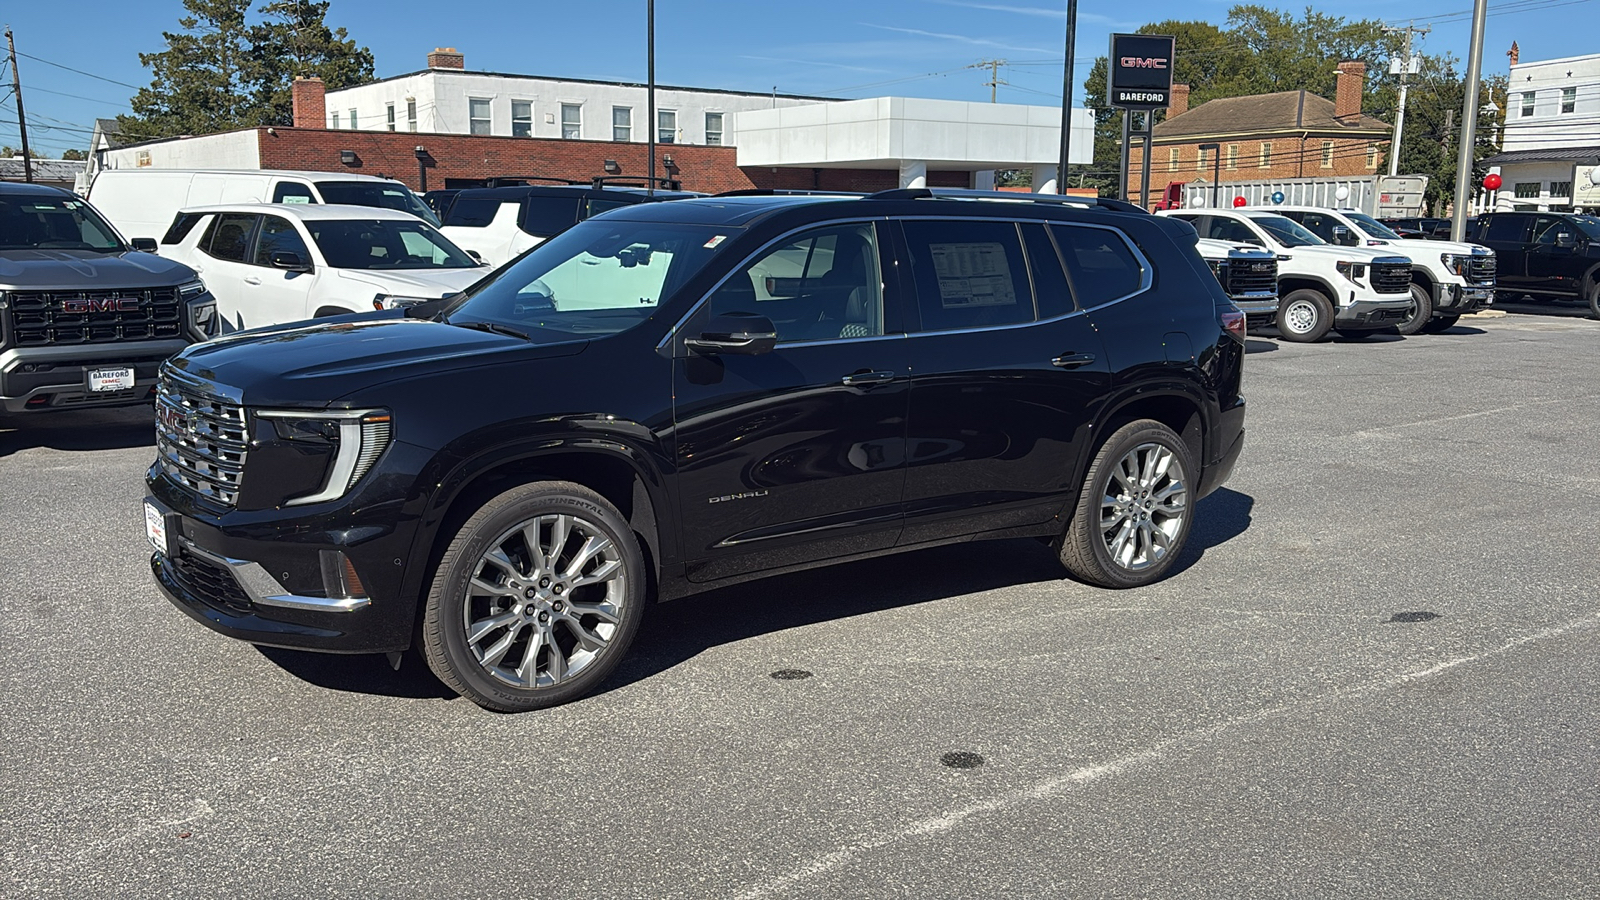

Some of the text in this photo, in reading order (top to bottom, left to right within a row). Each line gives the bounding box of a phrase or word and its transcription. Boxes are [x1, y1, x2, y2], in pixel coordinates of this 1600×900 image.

[1121, 57, 1167, 68] GMC
[1120, 93, 1163, 101] BAREFORD
[65, 298, 138, 313] GMC
[93, 371, 129, 379] BAREFORD
[158, 402, 187, 434] GMC
[708, 490, 768, 503] DENALI
[519, 498, 603, 516] CONTINENTAL
